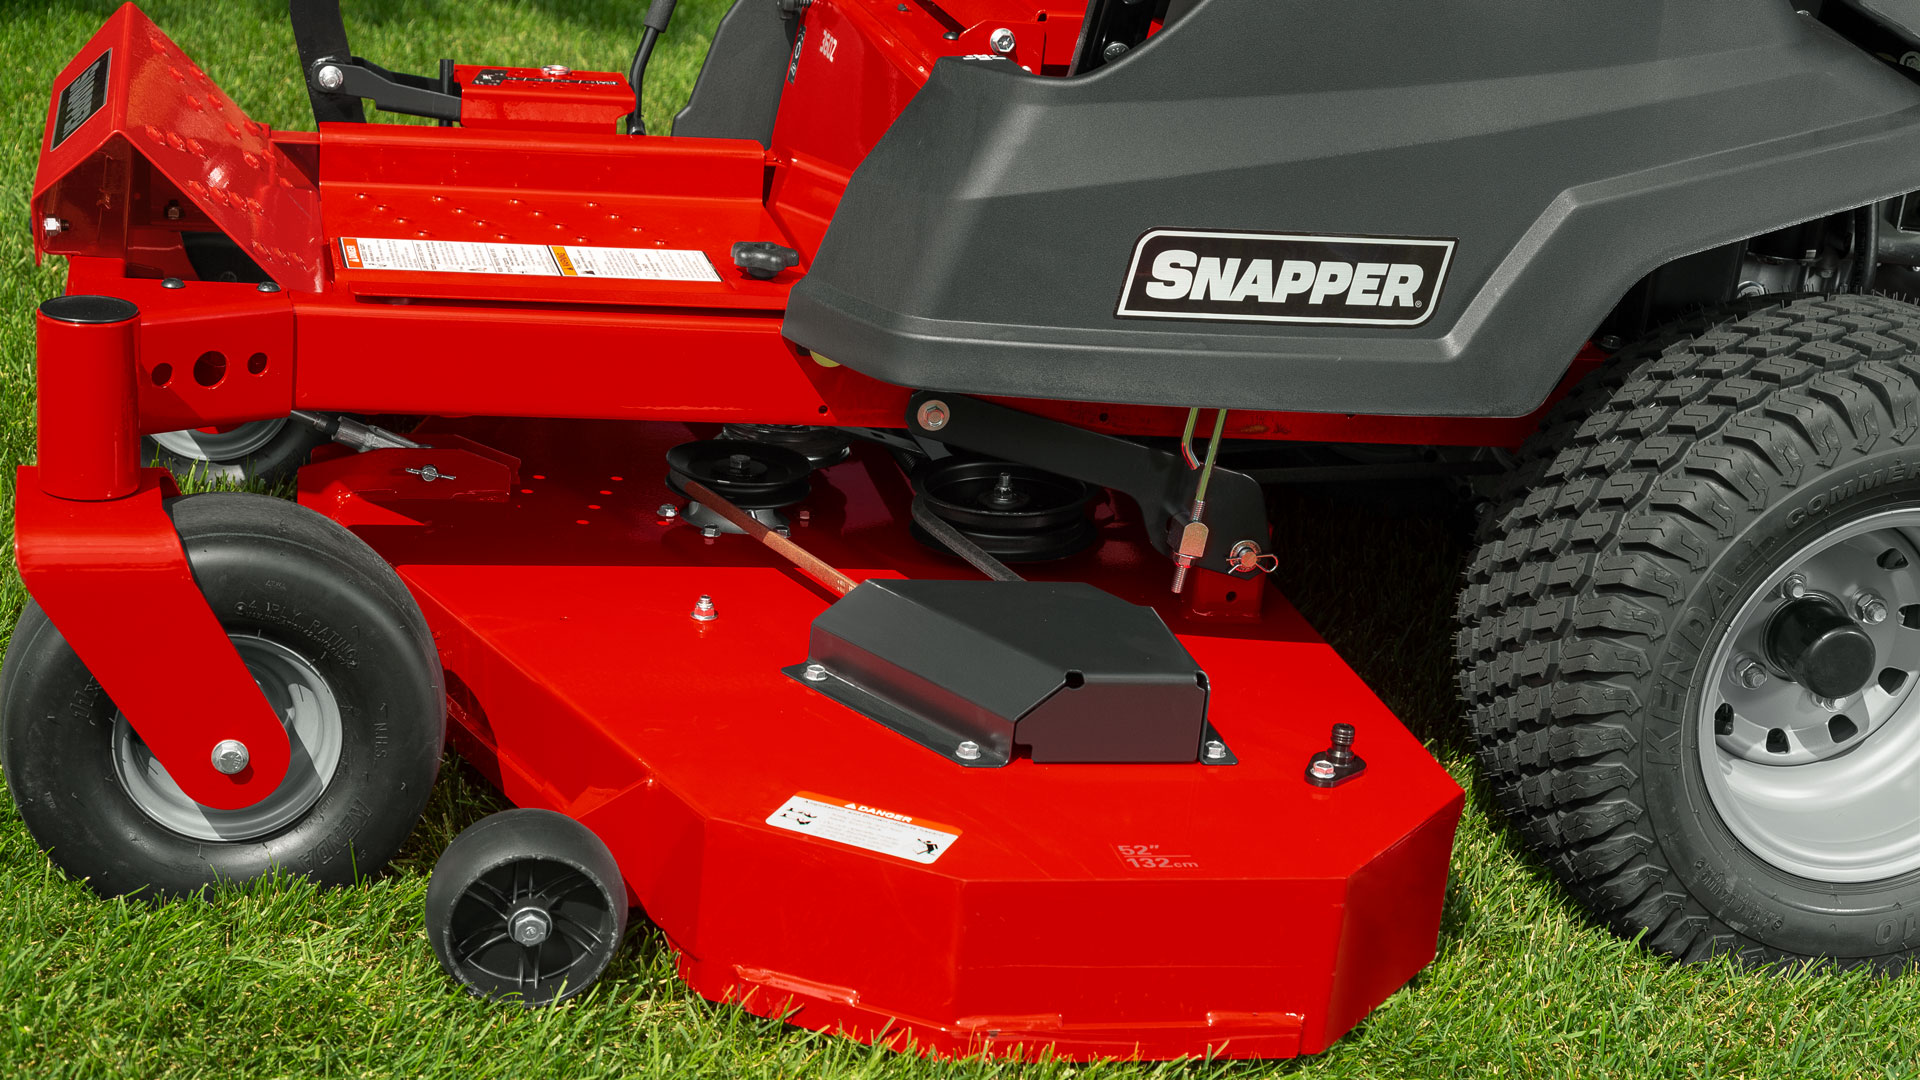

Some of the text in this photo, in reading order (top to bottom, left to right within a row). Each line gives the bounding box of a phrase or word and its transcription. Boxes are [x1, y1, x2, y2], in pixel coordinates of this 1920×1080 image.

[1146, 249, 1424, 307] SNAPPER
[1645, 571, 1738, 767] KENDA
[298, 797, 373, 874] KENDA
[857, 805, 913, 823] DANGER
[1117, 844, 1160, 856] 52"
